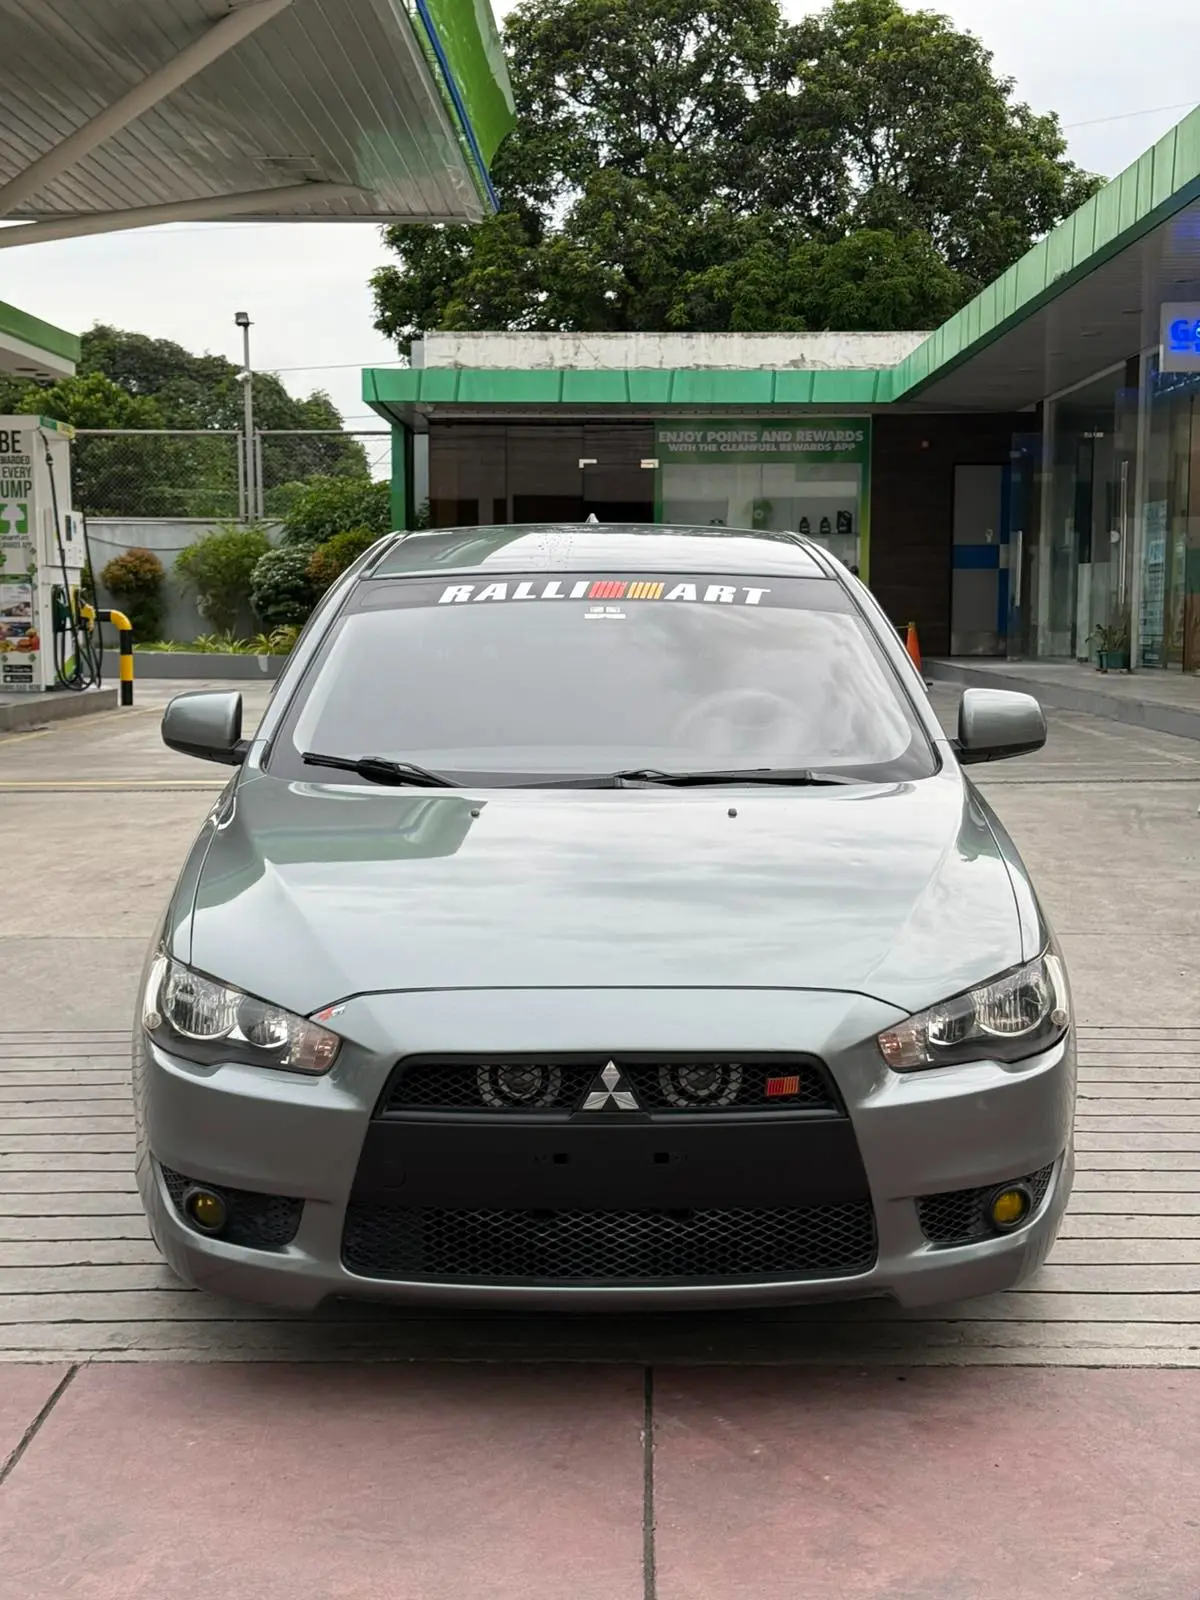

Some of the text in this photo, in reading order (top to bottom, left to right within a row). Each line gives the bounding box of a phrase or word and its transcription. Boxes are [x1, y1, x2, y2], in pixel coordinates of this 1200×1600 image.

[0, 430, 21, 453] BE
[659, 430, 864, 443] ENJOY POINTS AND REWARDS
[668, 442, 856, 452] WITH THE CLEANFUEL REWARDS APP
[2, 466, 31, 478] EVERY
